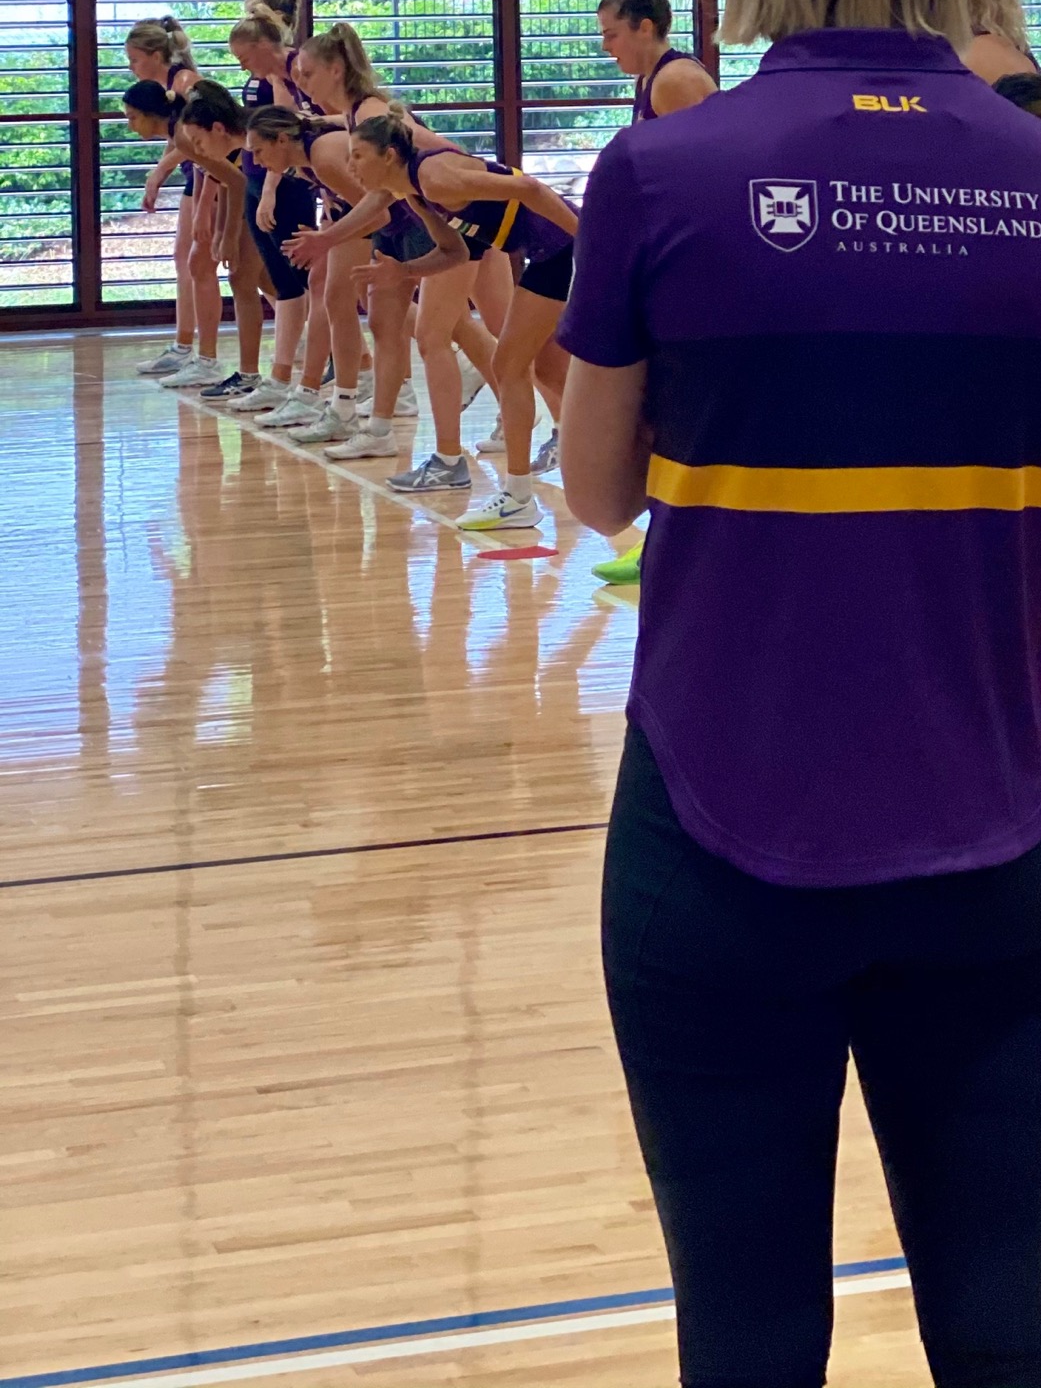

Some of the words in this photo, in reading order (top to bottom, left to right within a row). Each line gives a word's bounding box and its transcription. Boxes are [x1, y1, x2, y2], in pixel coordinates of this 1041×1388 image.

[852, 94, 928, 112] BLK
[829, 180, 885, 203] THE
[892, 182, 1040, 211] UNIVERSITY
[831, 209, 869, 231] OF
[836, 241, 969, 257] AUSTRALIA
